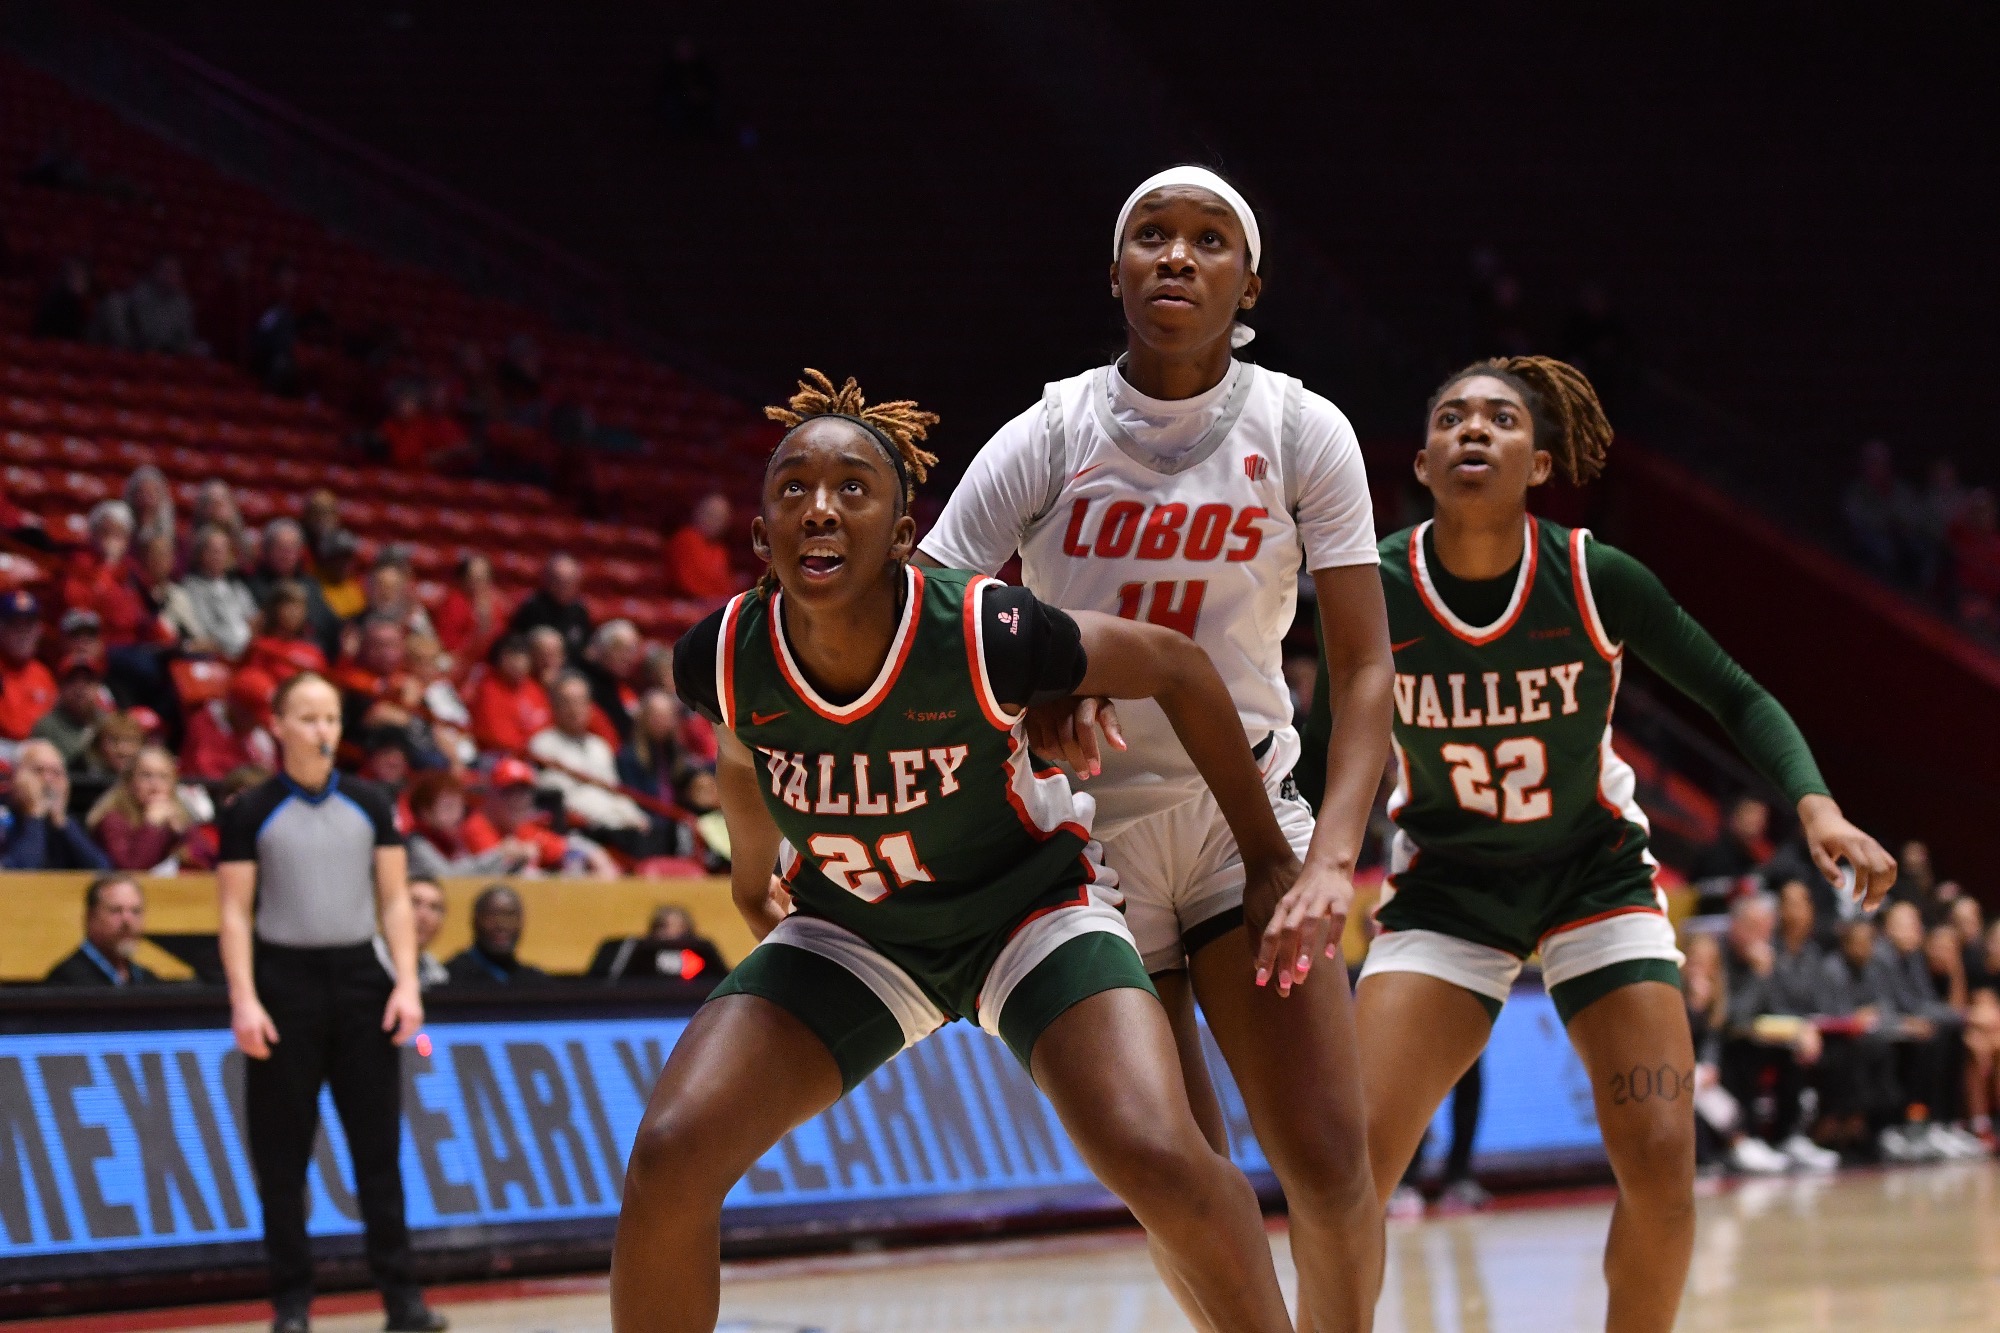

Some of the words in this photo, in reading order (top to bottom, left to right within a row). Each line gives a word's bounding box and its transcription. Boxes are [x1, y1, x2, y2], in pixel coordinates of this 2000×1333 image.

[1062, 498, 1269, 562] LOBOS
[1117, 580, 1209, 640] 14
[917, 709, 957, 722] SWAC
[1393, 661, 1585, 728] VALLEY
[755, 744, 969, 815] VALLEY
[1440, 736, 1553, 823] 22
[807, 830, 936, 904] 21
[0, 1051, 363, 1244] MEXI
